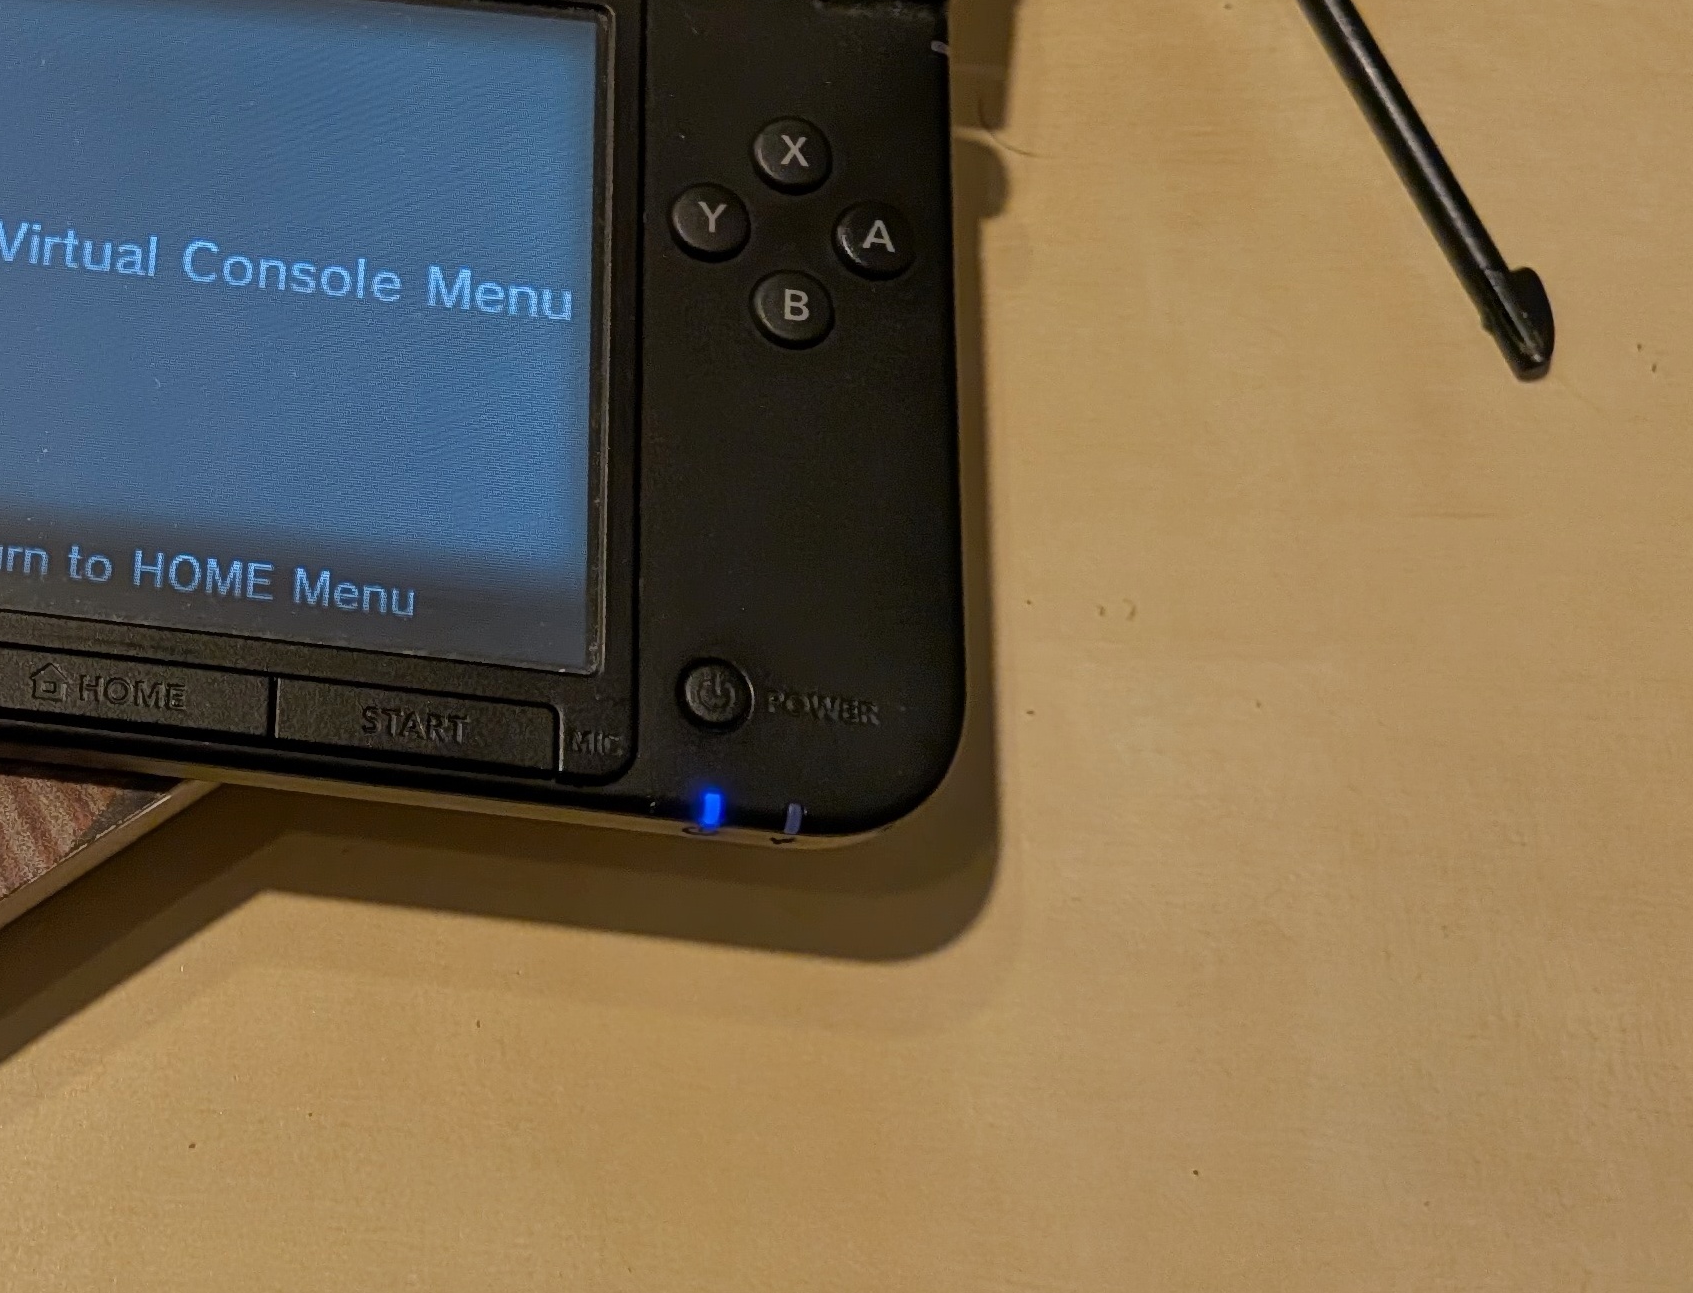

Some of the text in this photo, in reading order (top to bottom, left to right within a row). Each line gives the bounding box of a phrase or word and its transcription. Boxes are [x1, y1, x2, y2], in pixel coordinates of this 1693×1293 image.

[780, 134, 809, 167] X
[697, 201, 727, 233] Y
[862, 219, 896, 253] A
[182, 239, 403, 302] Console
[427, 265, 573, 321] Menu
[783, 288, 810, 321] B
[67, 544, 113, 583] to
[133, 549, 274, 601] HOME
[293, 568, 416, 617] Menu
[78, 674, 187, 708] HOME
[766, 689, 881, 727] POWER
[360, 705, 470, 745] START
[570, 729, 623, 757] MIC
